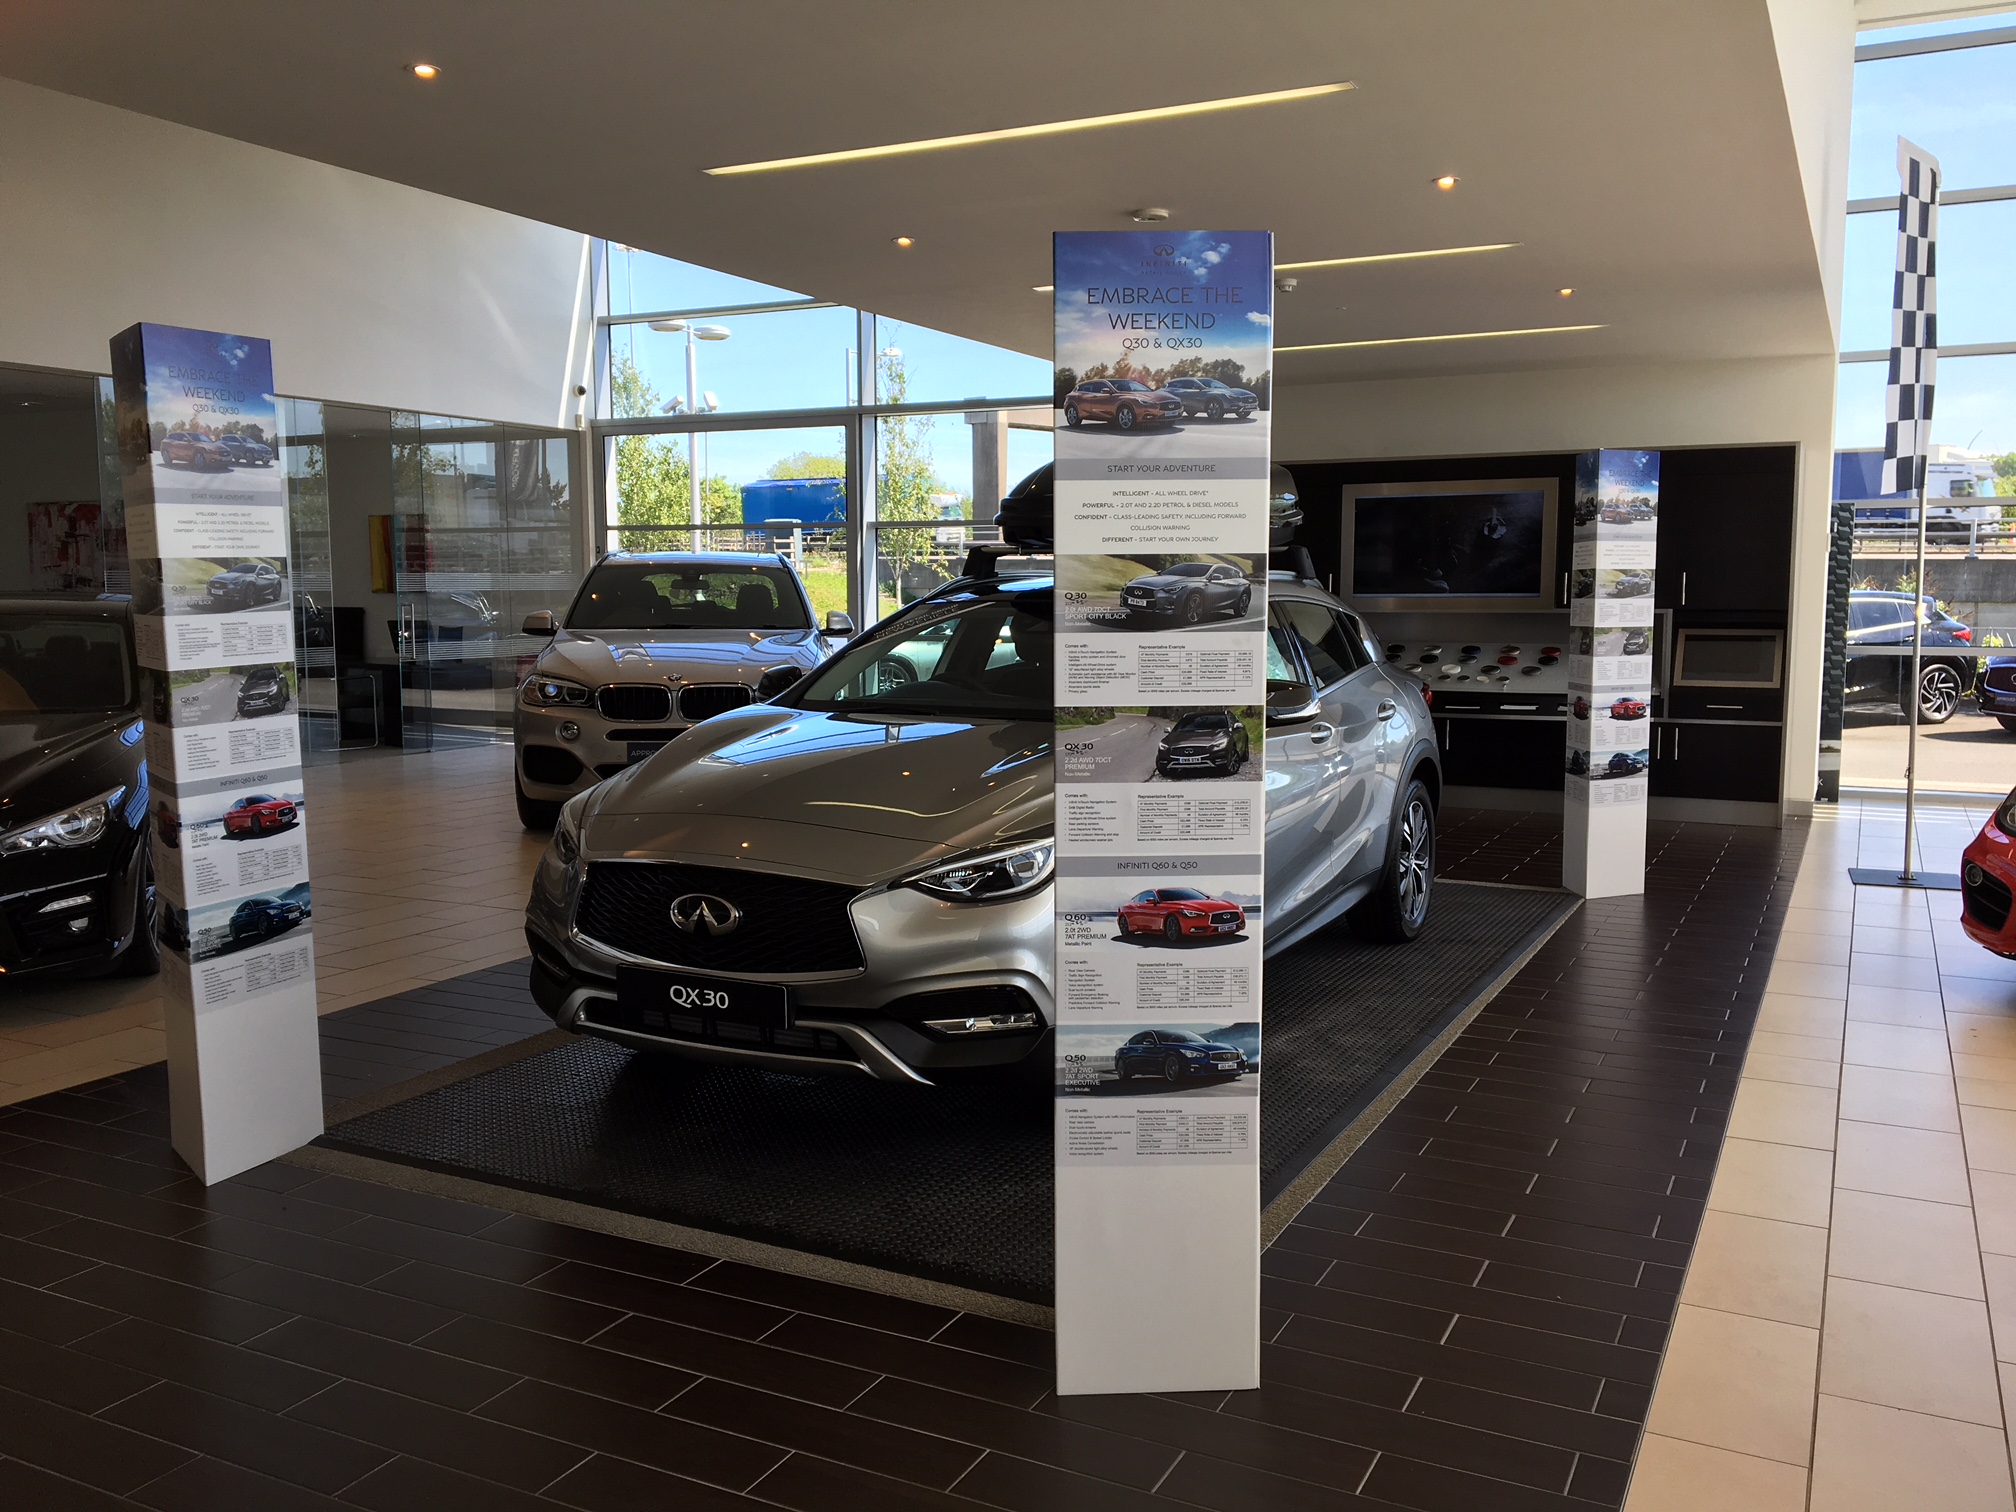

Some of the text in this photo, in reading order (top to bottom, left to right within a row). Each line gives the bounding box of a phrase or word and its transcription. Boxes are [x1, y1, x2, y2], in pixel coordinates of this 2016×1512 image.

[1087, 287, 1244, 304] EMBRACE THE
[1109, 313, 1216, 330] WEEKEND
[1122, 337, 1203, 351] Q30 & QX30
[168, 365, 259, 387] EMBRACE THE
[182, 385, 245, 403] WEEKEND
[192, 403, 240, 416] Q30 & QX30
[1107, 464, 1216, 473] START YOUR ADVENTURE
[1064, 592, 1087, 601] Q30
[1064, 742, 1094, 752] QX30
[220, 779, 240, 787] INFINITI
[1151, 862, 1170, 870] Q60
[1179, 861, 1198, 870] Q50
[1064, 913, 1086, 922] Q60
[669, 985, 729, 1009] QX30
[1064, 1054, 1086, 1063] Q50
